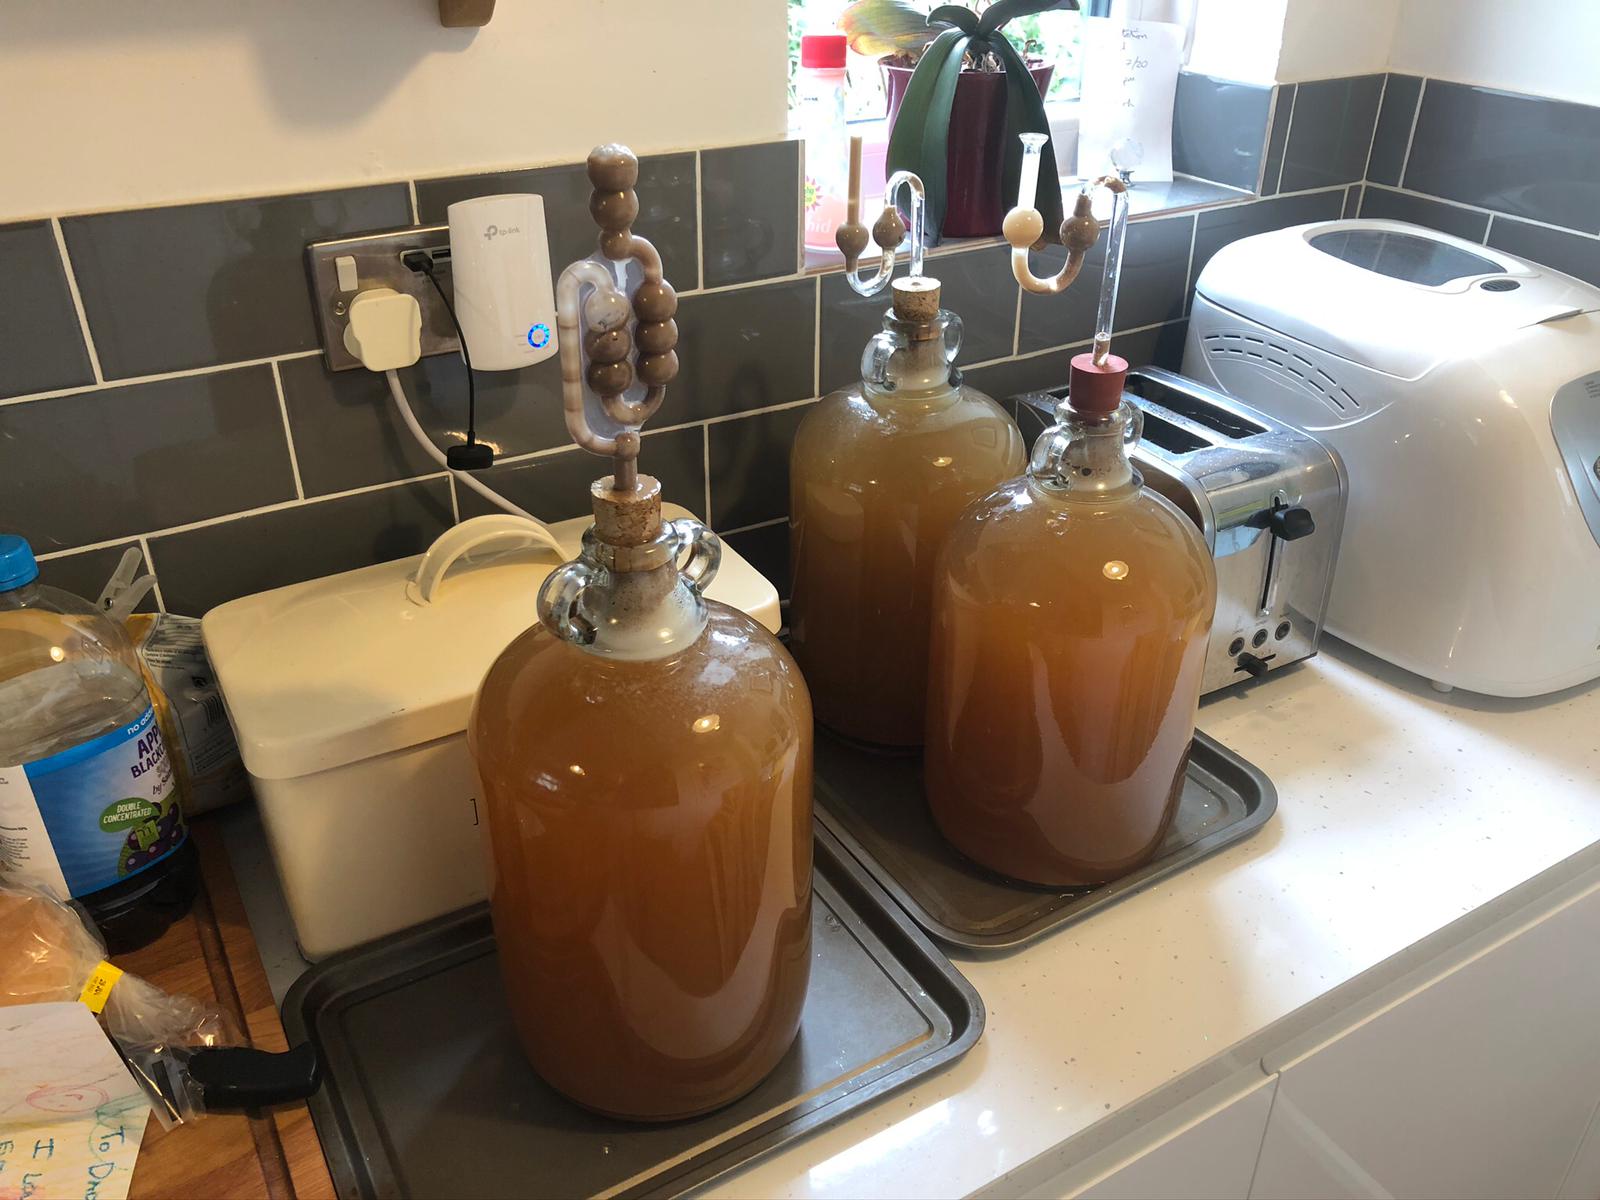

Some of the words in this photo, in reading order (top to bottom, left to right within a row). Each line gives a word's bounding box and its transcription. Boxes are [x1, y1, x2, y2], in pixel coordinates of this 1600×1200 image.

[127, 724, 140, 735] no
[117, 801, 142, 813] DOUBLE
[103, 807, 152, 824] CONCENTRATED
[99, 1125, 125, 1152] To
